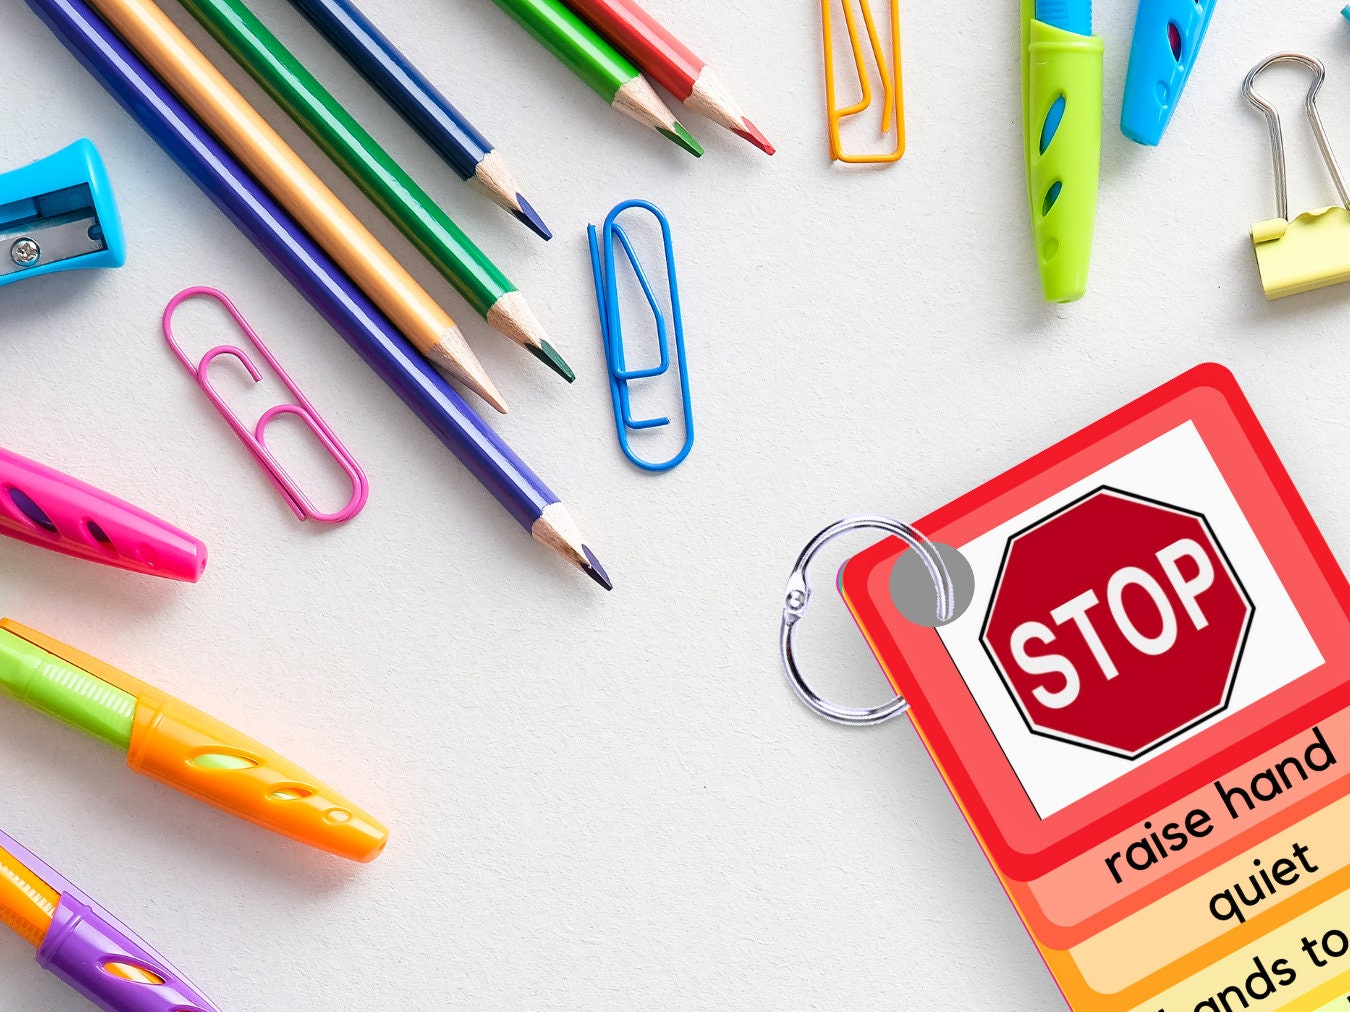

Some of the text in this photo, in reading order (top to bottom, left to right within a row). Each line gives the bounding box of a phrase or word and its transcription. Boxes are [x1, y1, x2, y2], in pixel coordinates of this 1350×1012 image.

[1010, 538, 1214, 709] STOP
[1104, 726, 1337, 884] raise hand
[1209, 842, 1319, 924] quiet
[1301, 929, 1349, 968] to
